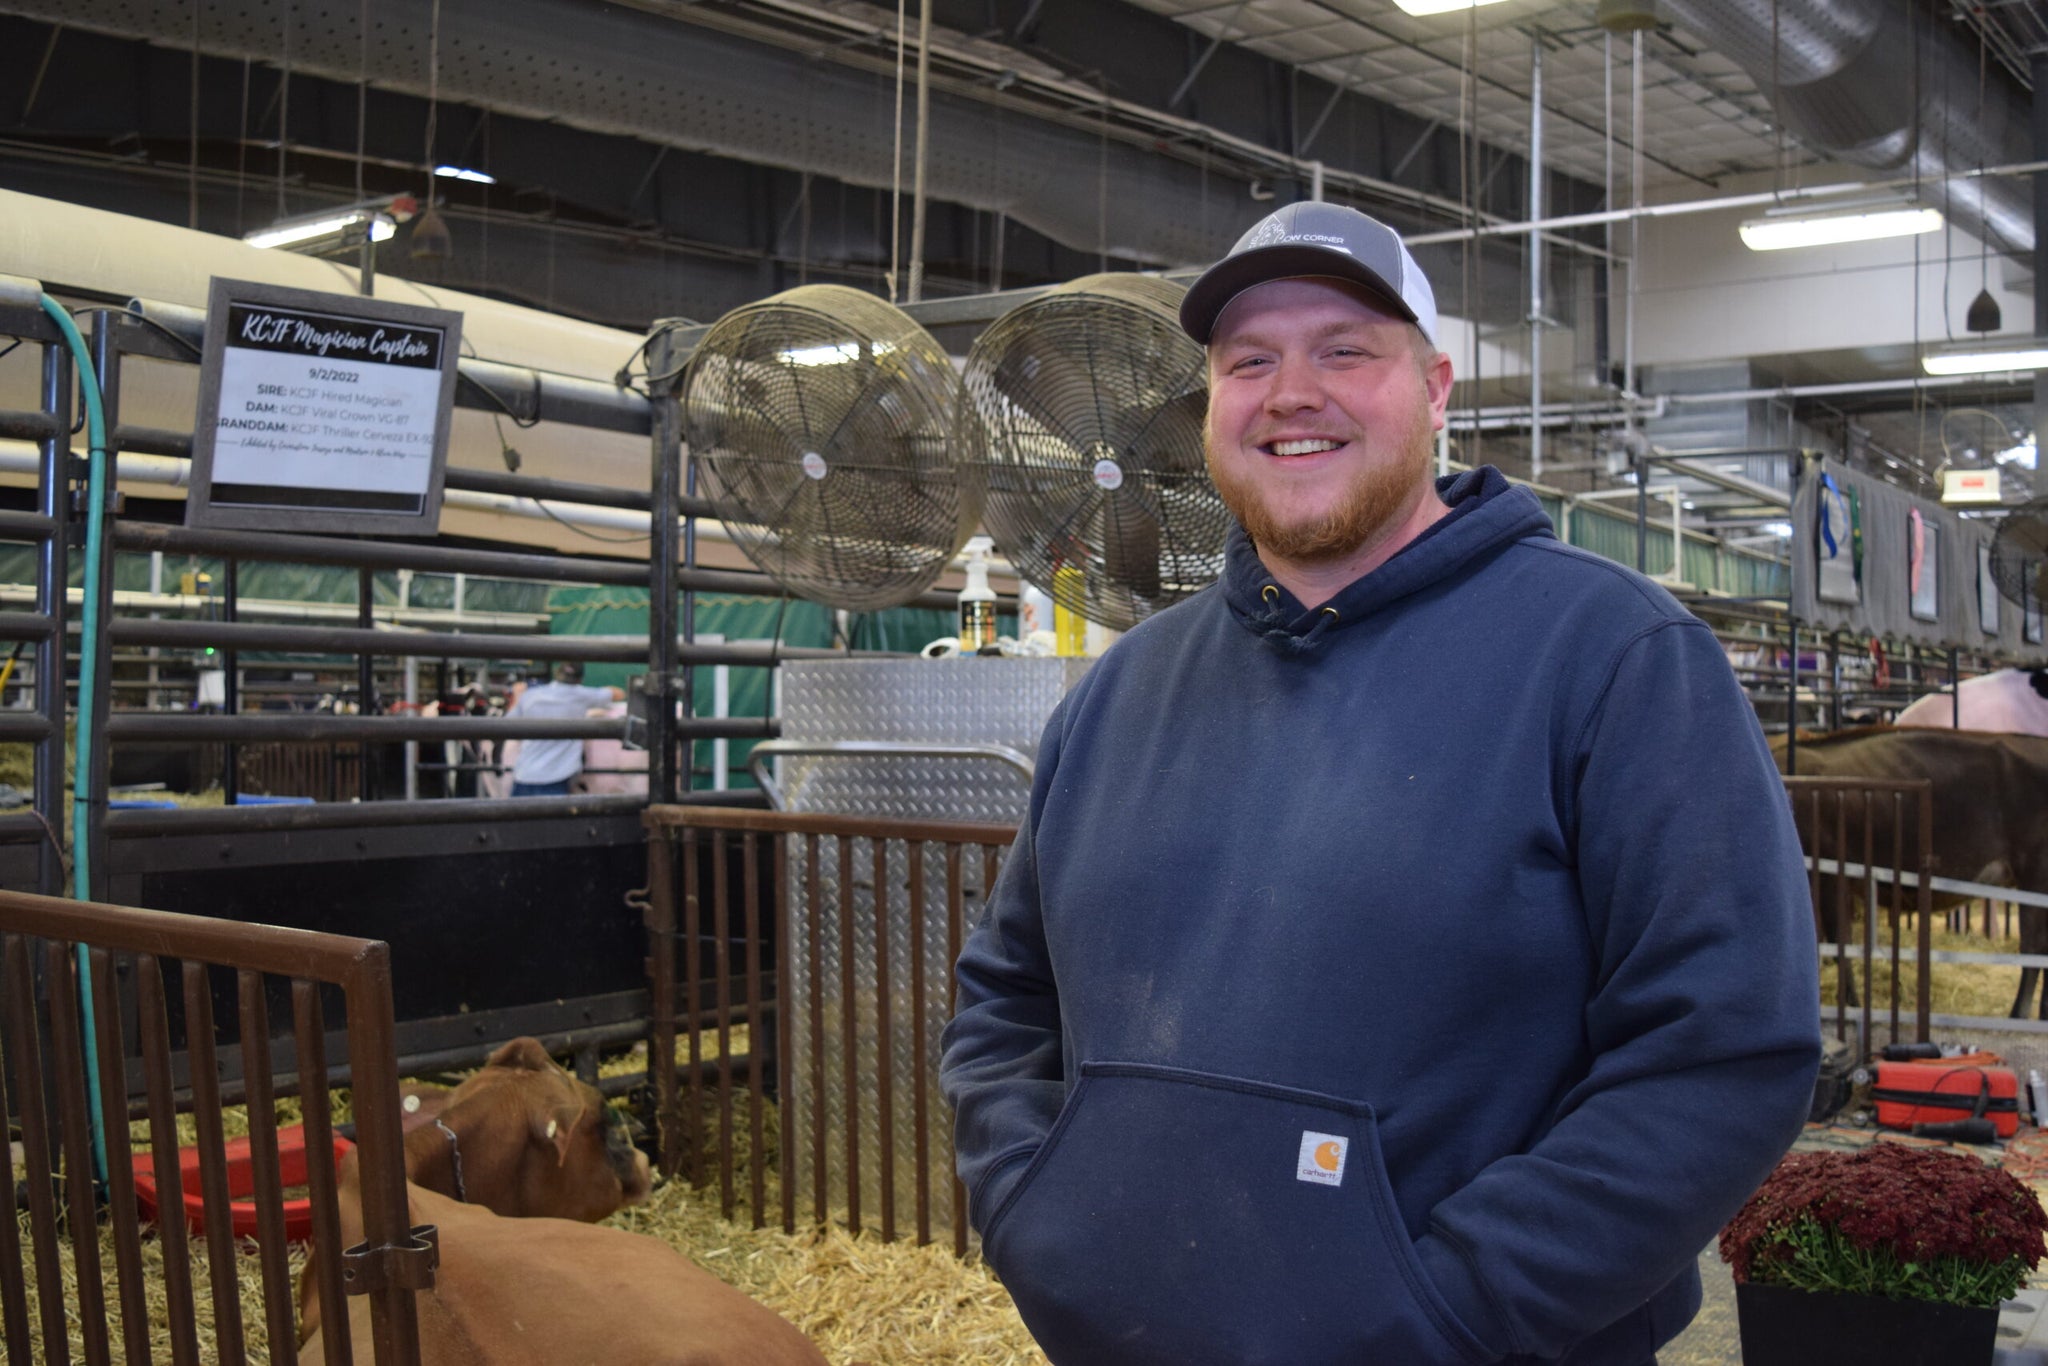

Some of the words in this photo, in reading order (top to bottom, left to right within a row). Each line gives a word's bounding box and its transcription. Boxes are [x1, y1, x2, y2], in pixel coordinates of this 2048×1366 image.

[1302, 234, 1344, 245] CORNER
[242, 313, 293, 343] KCJF
[294, 320, 367, 355] Magician
[369, 329, 429, 362] Captain
[308, 368, 359, 383] 9/2/2022
[257, 384, 287, 396] SIRE:
[321, 391, 352, 403] Hired
[355, 393, 402, 408] Magician
[246, 401, 278, 413] DAM:
[340, 410, 375, 422] Crown
[323, 425, 360, 438] Thriller
